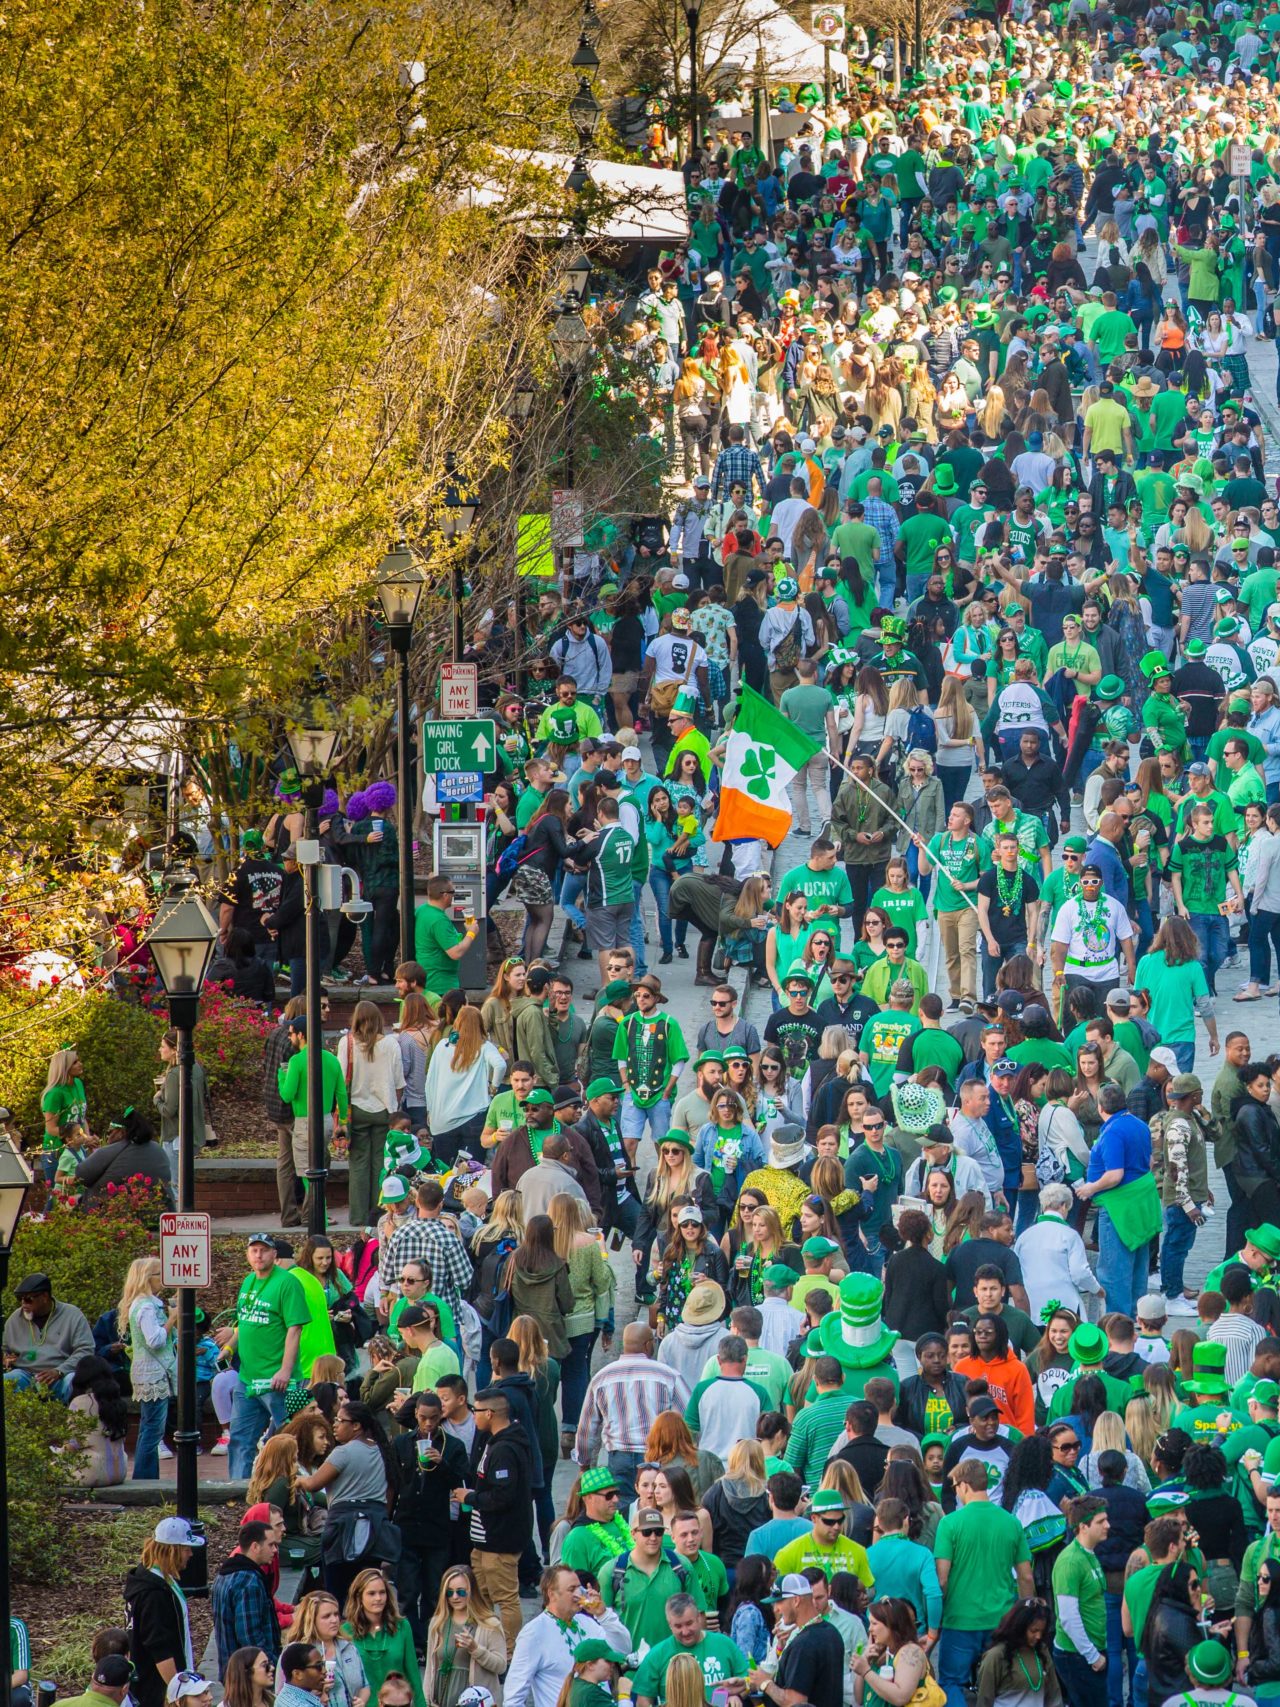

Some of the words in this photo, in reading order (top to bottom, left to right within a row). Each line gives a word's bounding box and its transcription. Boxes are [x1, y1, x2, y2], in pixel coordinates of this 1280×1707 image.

[441, 667, 452, 678] NO
[453, 668, 475, 676] PARKING
[449, 686, 469, 696] ANY
[448, 699, 470, 709] TIME
[427, 724, 463, 739] WAVING
[437, 741, 458, 755] GIRL
[434, 757, 461, 771] DOCK
[458, 774, 480, 785] Cash
[615, 846, 632, 864] 17
[883, 899, 914, 907] IRISH
[162, 1219, 176, 1233] NO
[176, 1220, 207, 1231] PARKING
[172, 1245, 198, 1258] ANY
[170, 1263, 201, 1277] TIME
